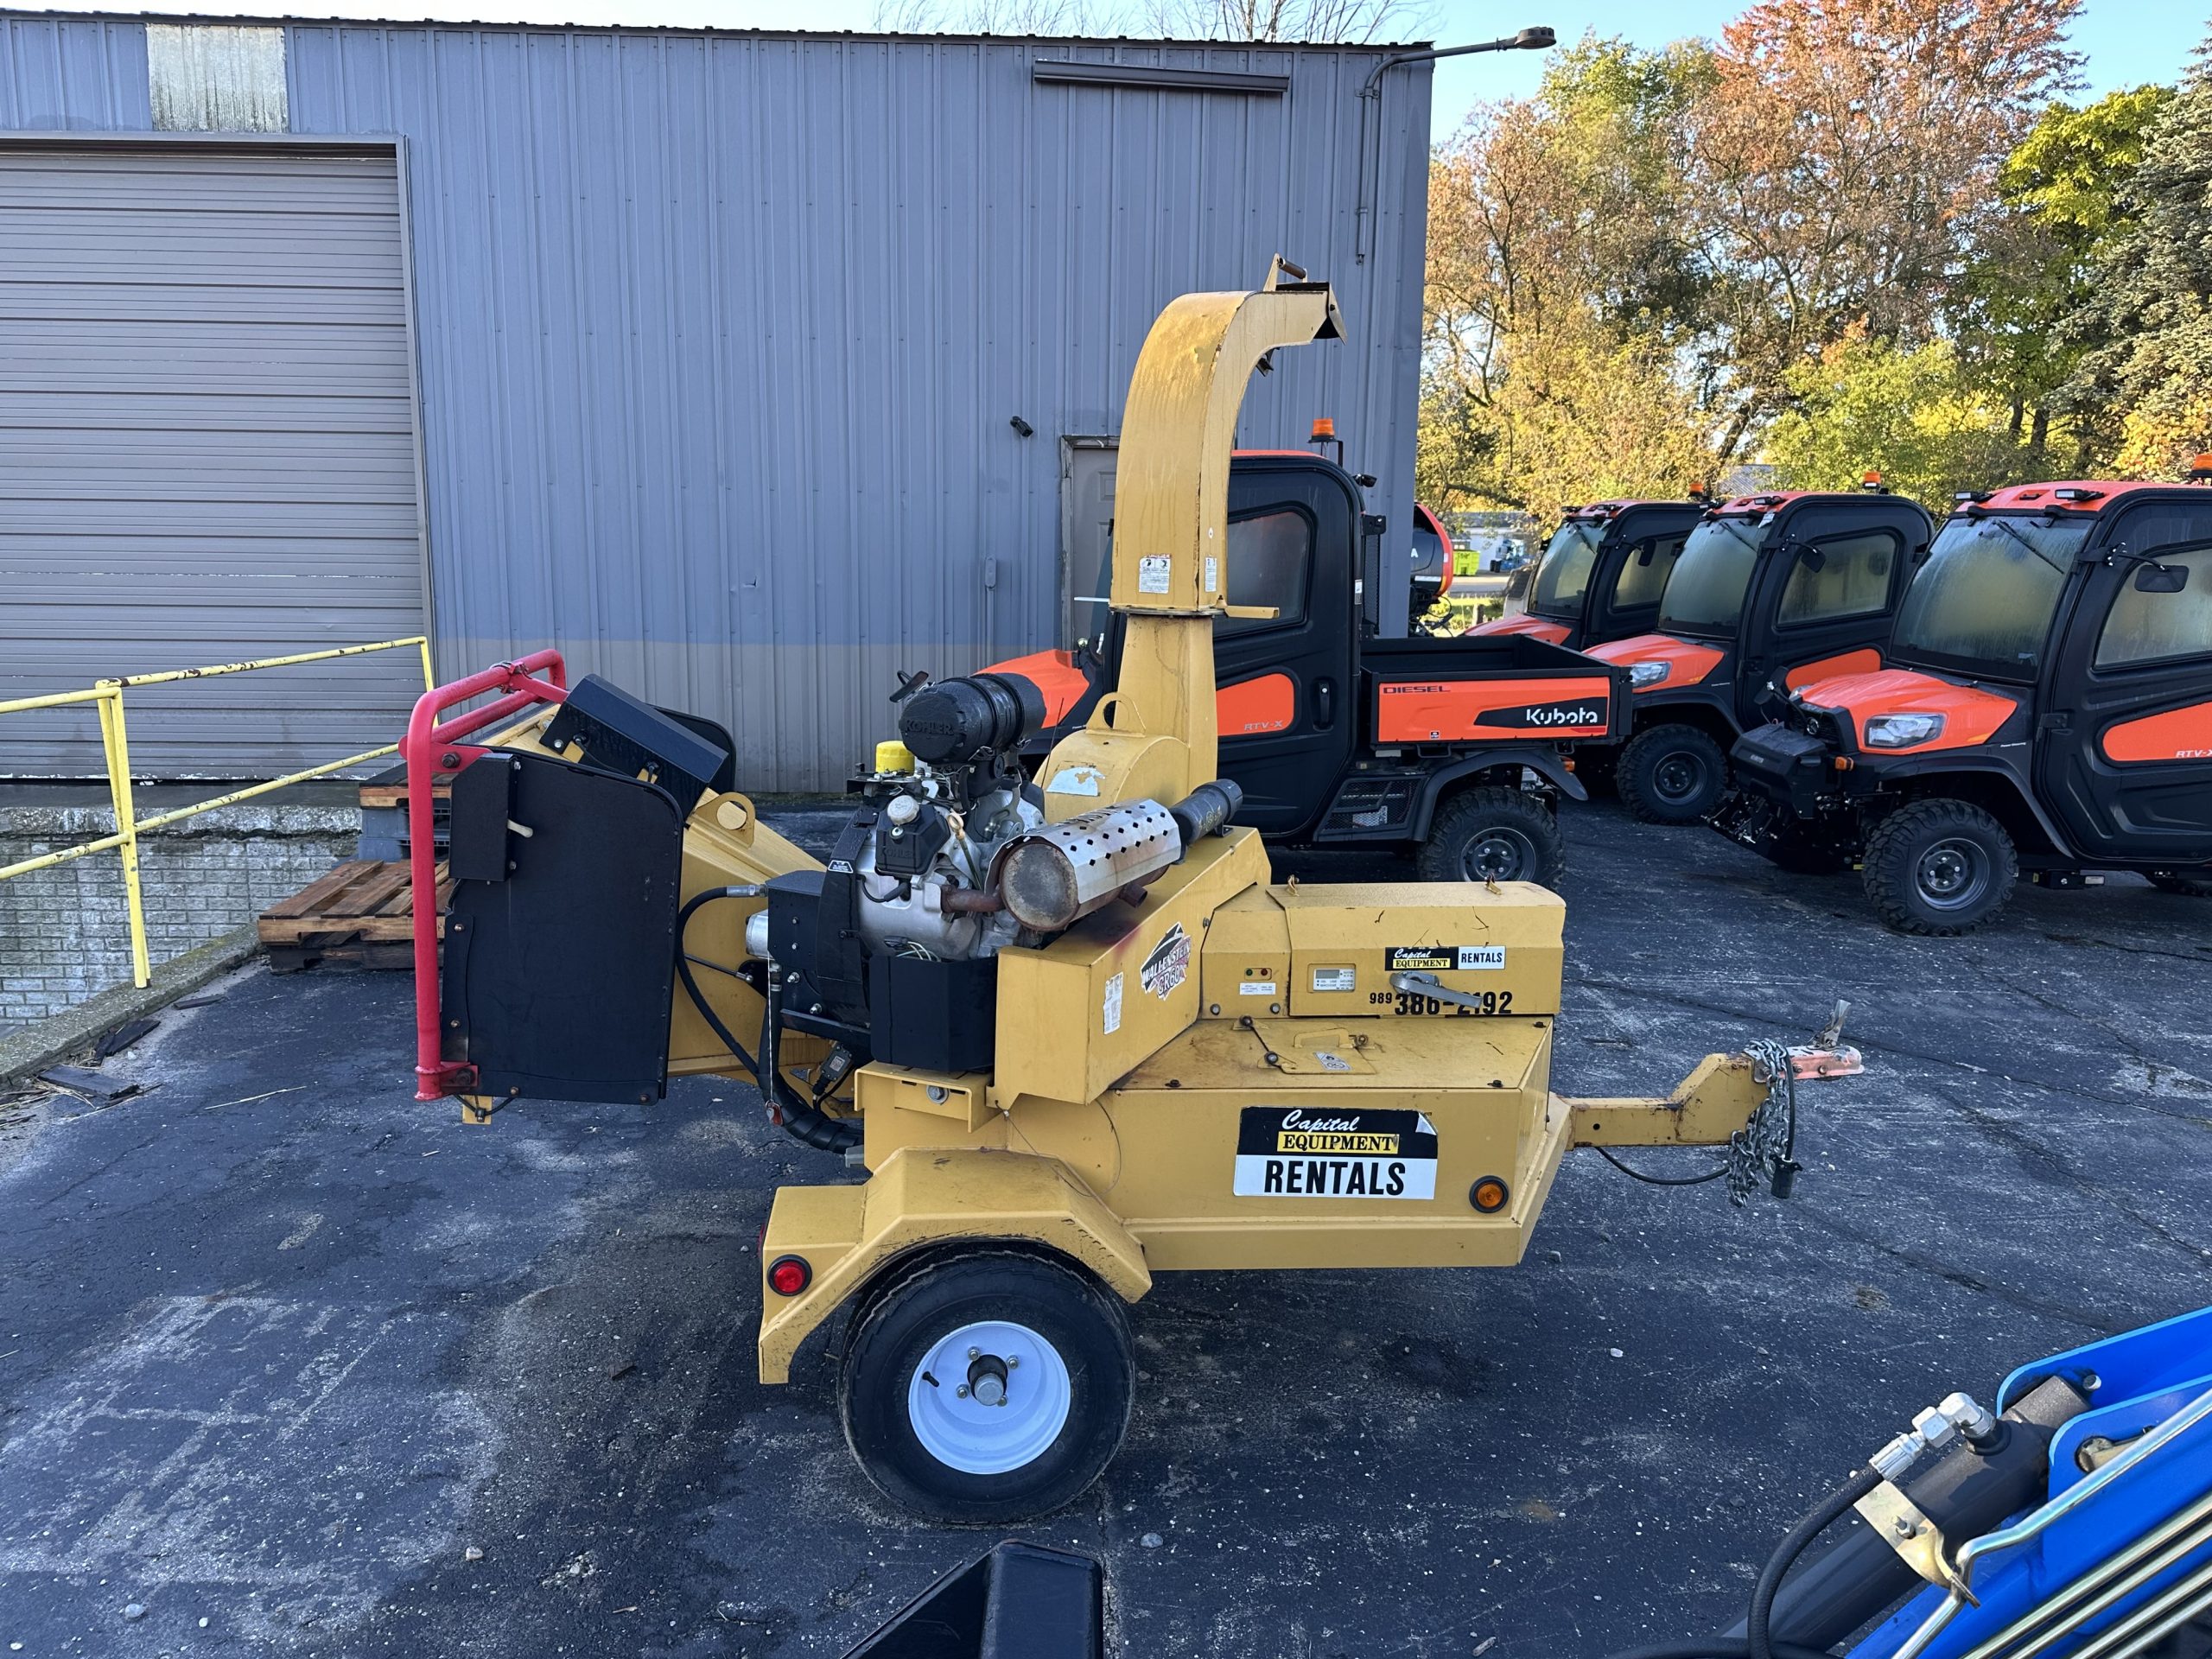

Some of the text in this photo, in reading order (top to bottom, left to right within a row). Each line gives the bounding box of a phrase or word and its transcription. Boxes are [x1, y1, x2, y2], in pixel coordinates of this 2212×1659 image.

[1383, 685, 1451, 694] DIESEL
[1526, 707, 1598, 725] Kubota
[905, 720, 952, 735] KOHLER
[1244, 720, 1283, 731] RTV-X
[1394, 948, 1431, 960] Capital
[1460, 952, 1503, 963] RENTALS
[1141, 941, 1191, 983] WALLENSTEIN
[1395, 959, 1447, 968] EQUIPMENT
[1370, 992, 1392, 1004] 989
[1281, 1109, 1360, 1133] Capital
[1282, 1134, 1394, 1152] EQUIPMENT
[1263, 1160, 1406, 1196] RENTALS
